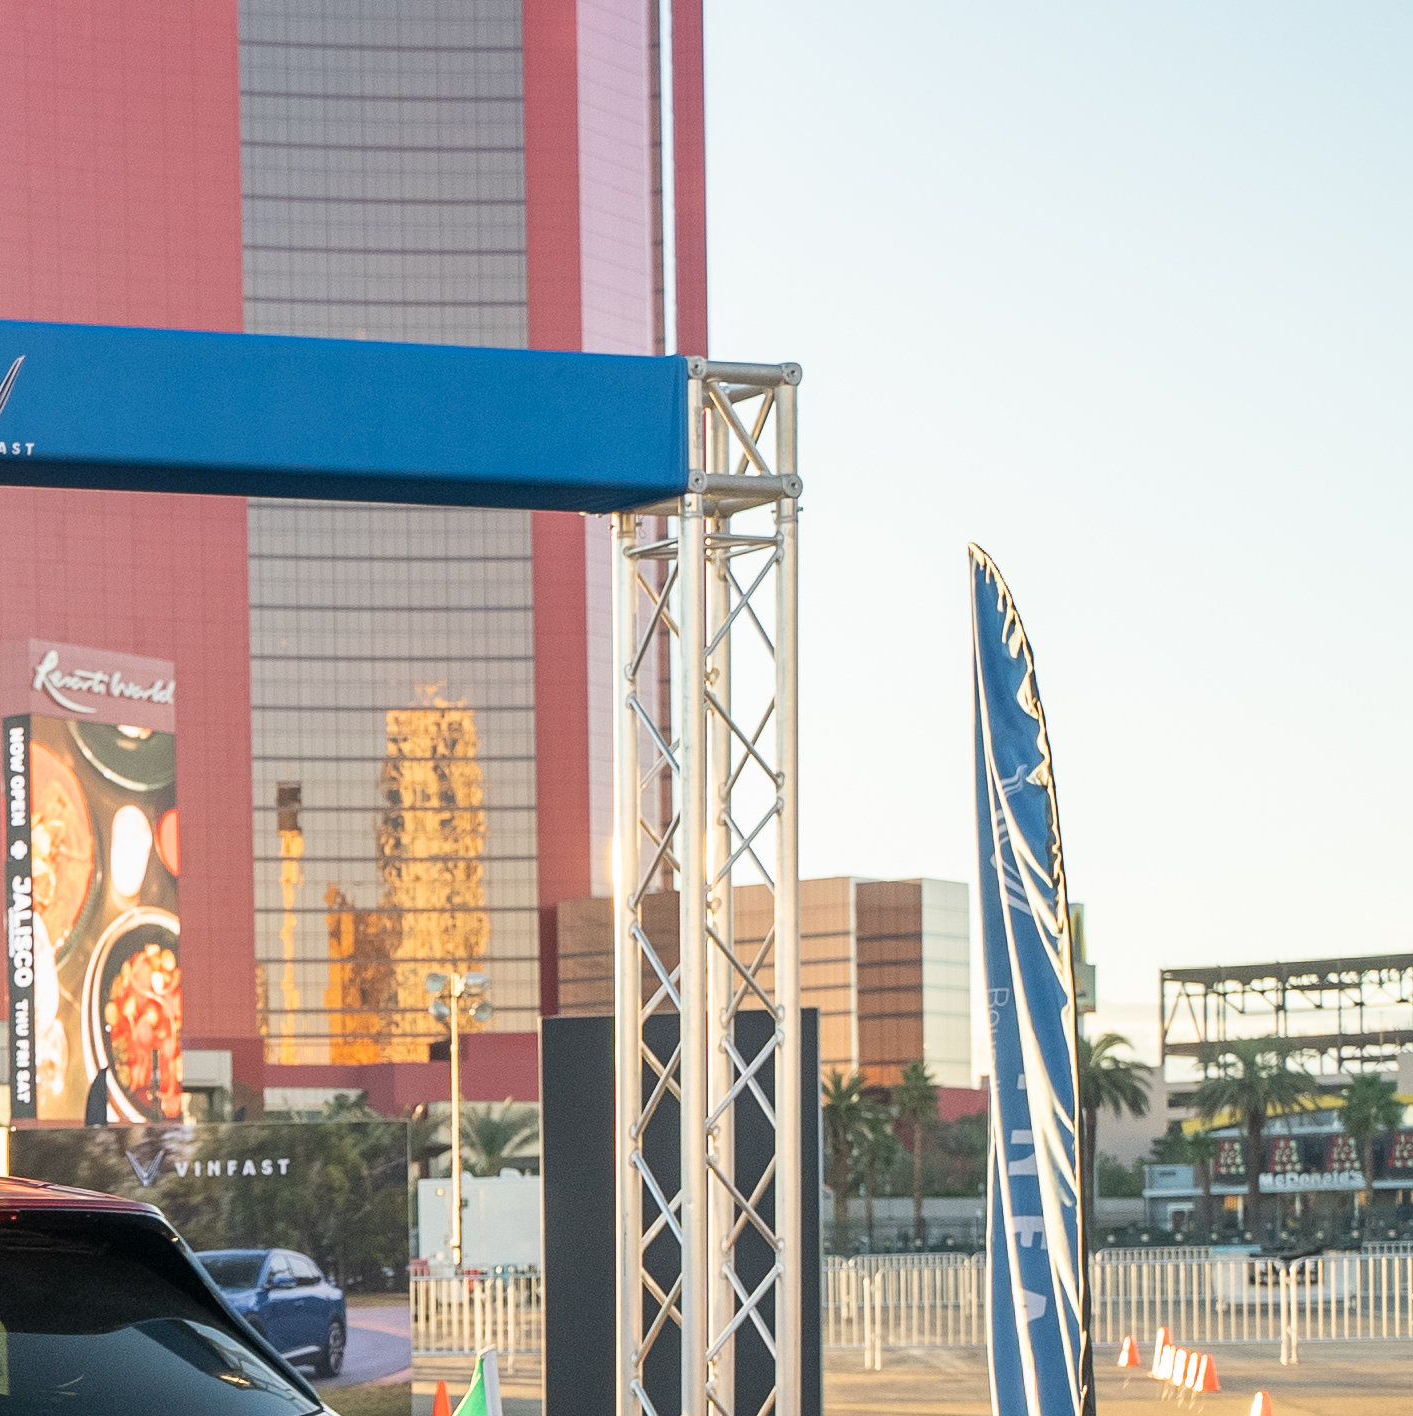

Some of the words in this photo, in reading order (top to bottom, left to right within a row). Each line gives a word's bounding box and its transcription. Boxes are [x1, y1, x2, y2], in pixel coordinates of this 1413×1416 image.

[9, 726, 25, 773] NOW
[10, 774, 26, 827] OPEN
[11, 875, 33, 988] JALISCO
[175, 1157, 291, 1178] VINFAST
